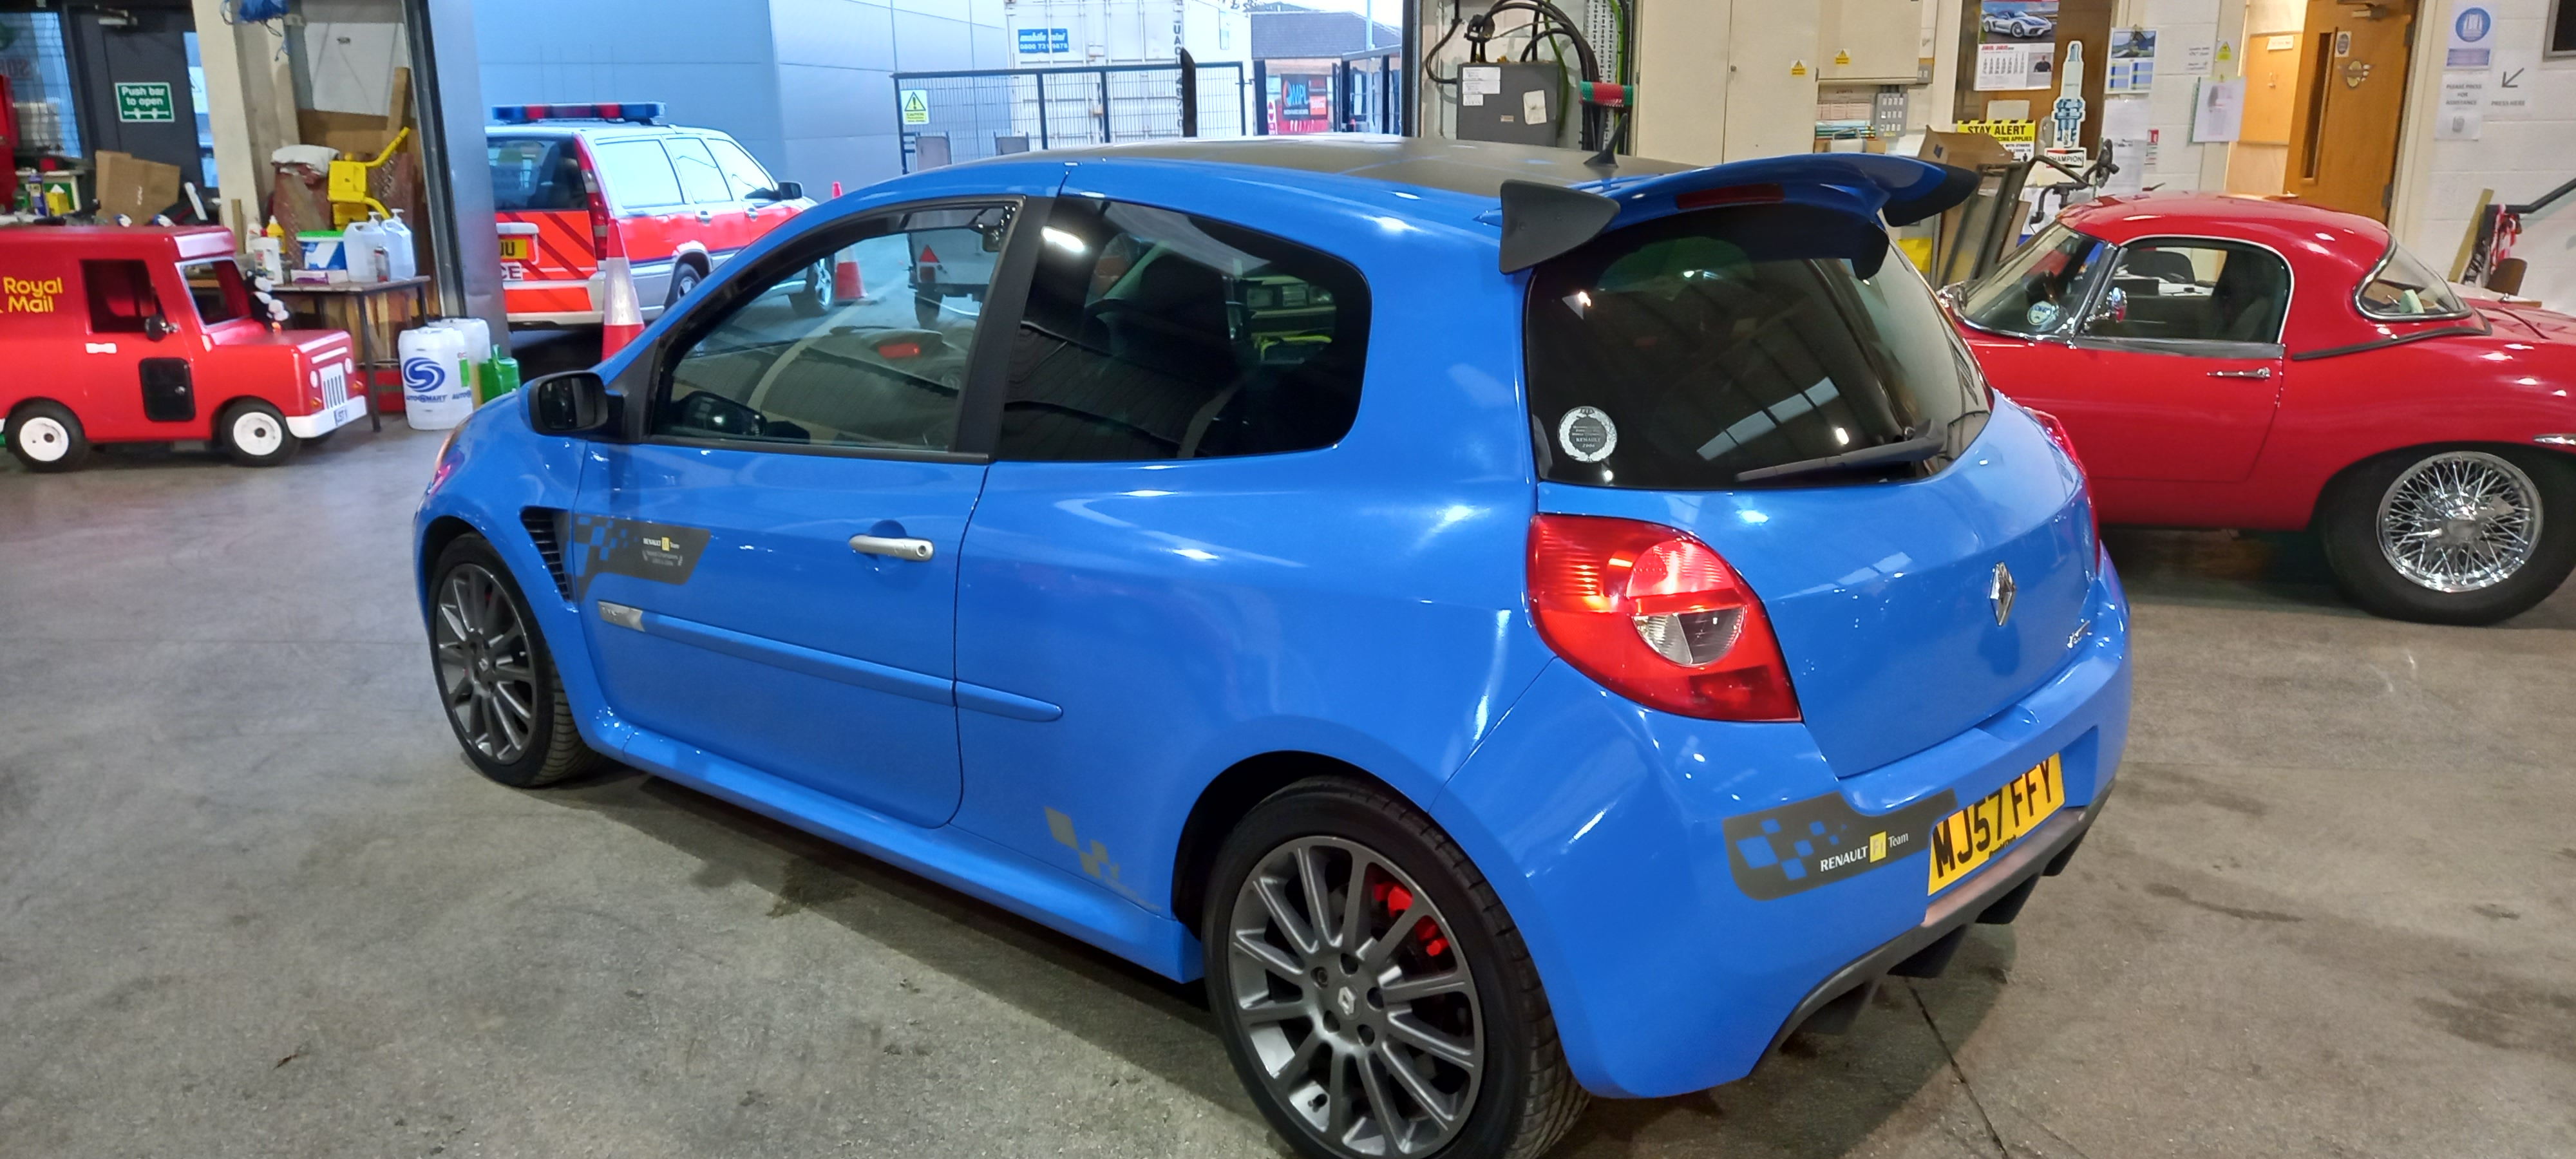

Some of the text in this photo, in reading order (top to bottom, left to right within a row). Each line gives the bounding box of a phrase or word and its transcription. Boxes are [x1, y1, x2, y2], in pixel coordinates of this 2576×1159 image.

[1020, 32, 1046, 42] mobile
[121, 86, 165, 96] Push bar
[126, 97, 164, 107] to open
[1967, 125, 2026, 135] STAY ALERT
[3, 276, 64, 298] Royal
[8, 295, 54, 313] Mail
[1933, 758, 2052, 879] MJ57 FFY
[1820, 845, 1868, 872] RENAULT
[1888, 833, 1909, 848] Team
